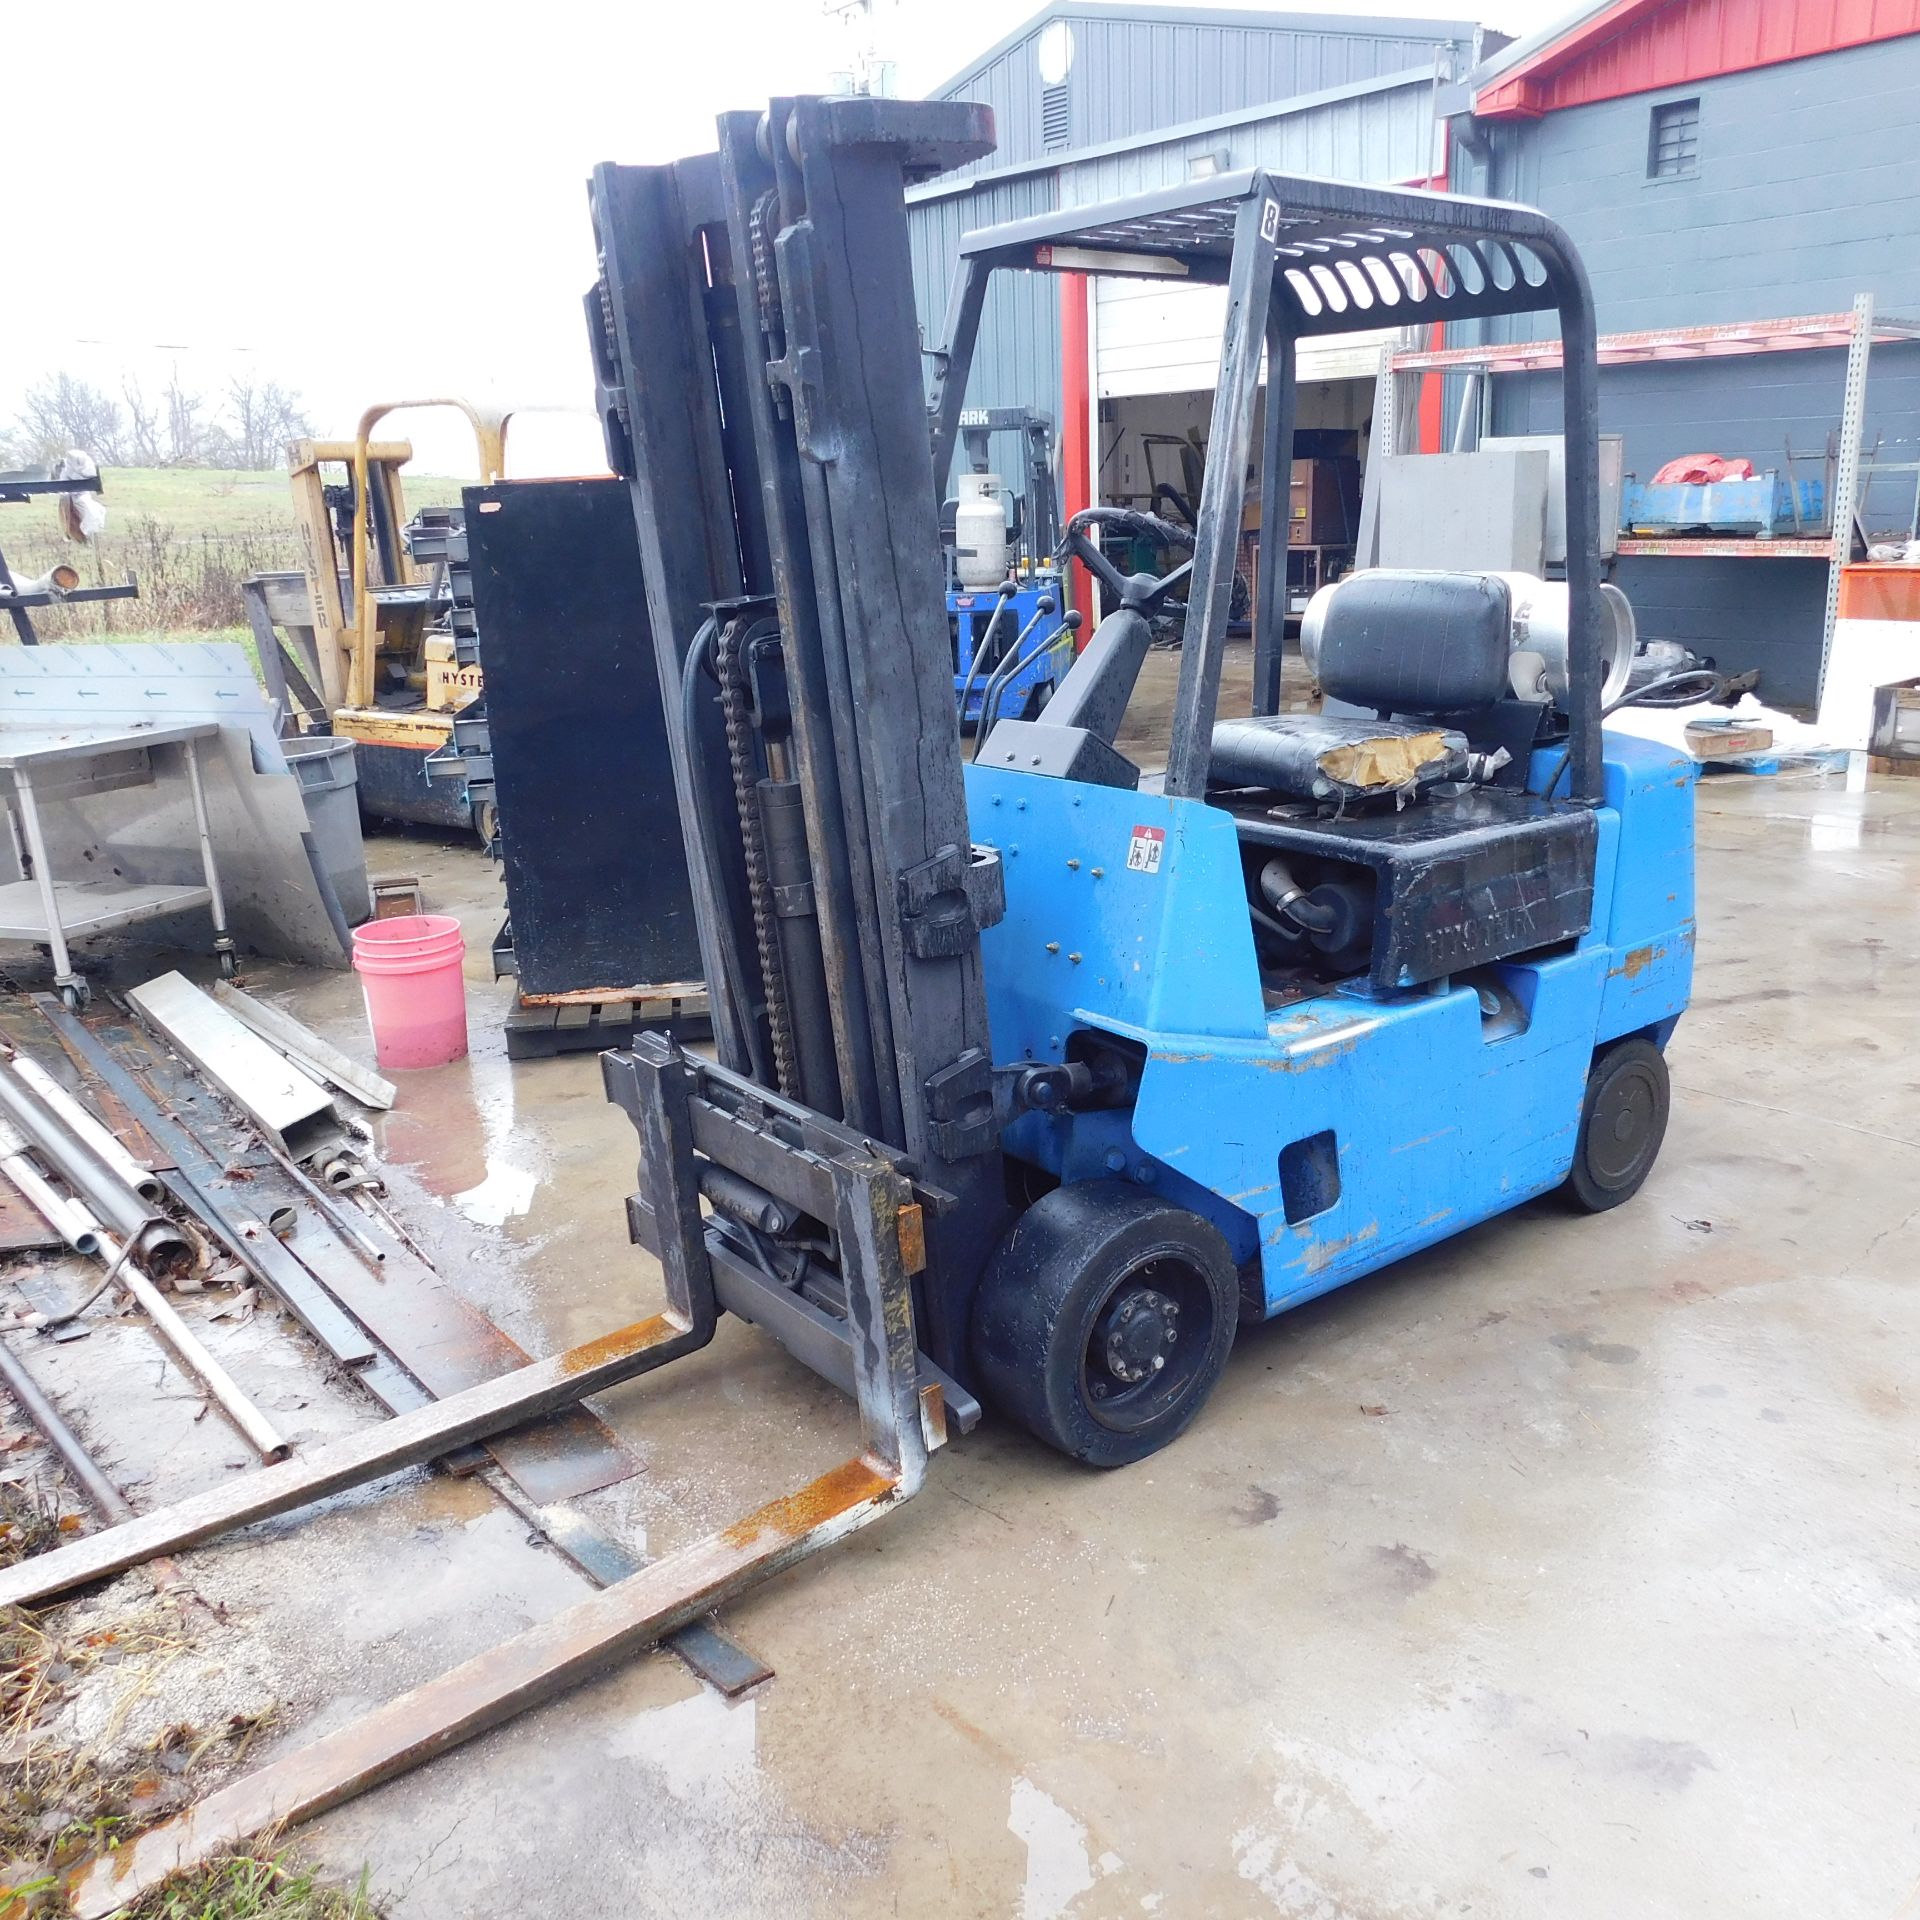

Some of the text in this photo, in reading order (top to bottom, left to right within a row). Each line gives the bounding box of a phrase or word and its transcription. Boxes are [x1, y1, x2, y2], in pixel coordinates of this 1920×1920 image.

[1264, 203, 1277, 238] 8
[959, 409, 990, 426] ARK
[301, 521, 328, 629] HYSTER
